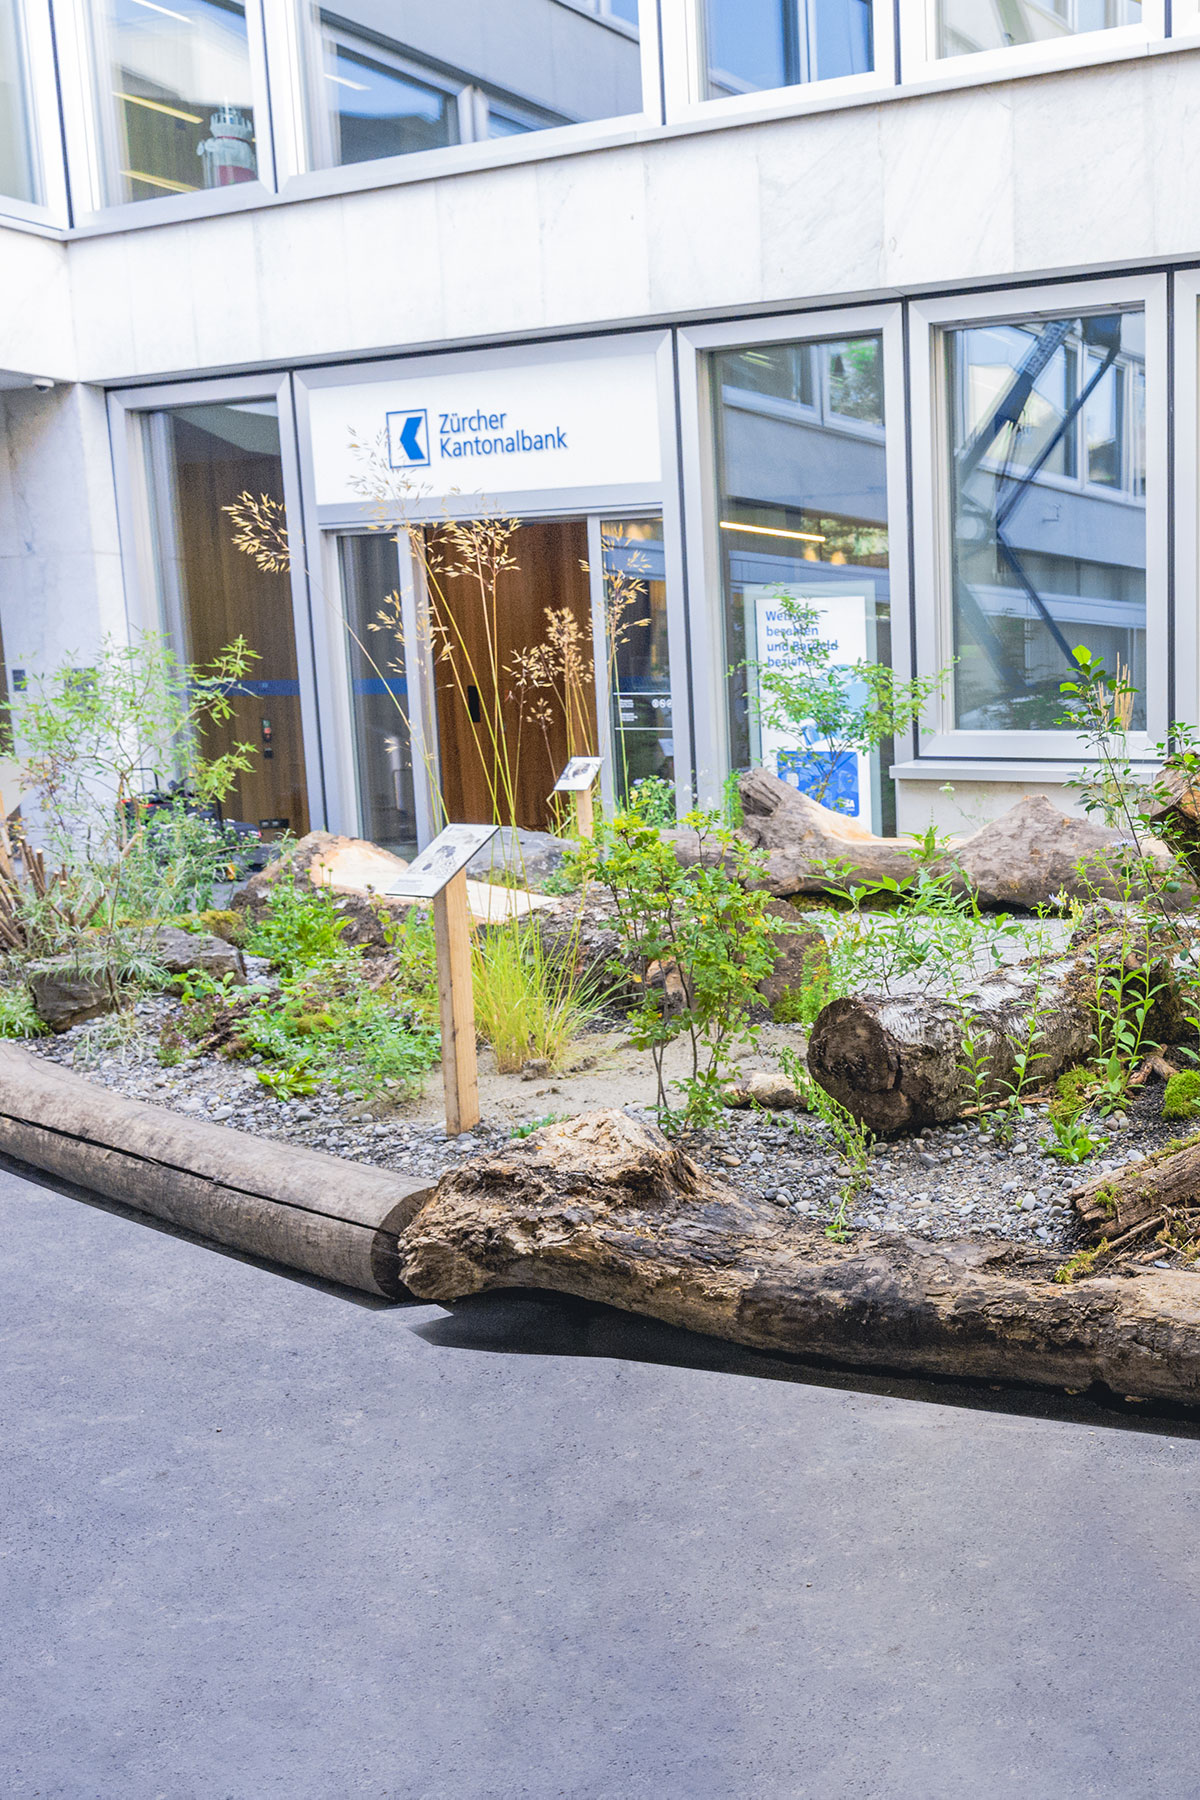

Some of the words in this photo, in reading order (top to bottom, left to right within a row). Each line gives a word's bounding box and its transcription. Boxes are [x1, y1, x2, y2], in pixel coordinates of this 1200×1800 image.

[438, 409, 507, 434] Zürcher
[440, 426, 568, 458] Kantonalbank
[767, 641, 789, 652] und
